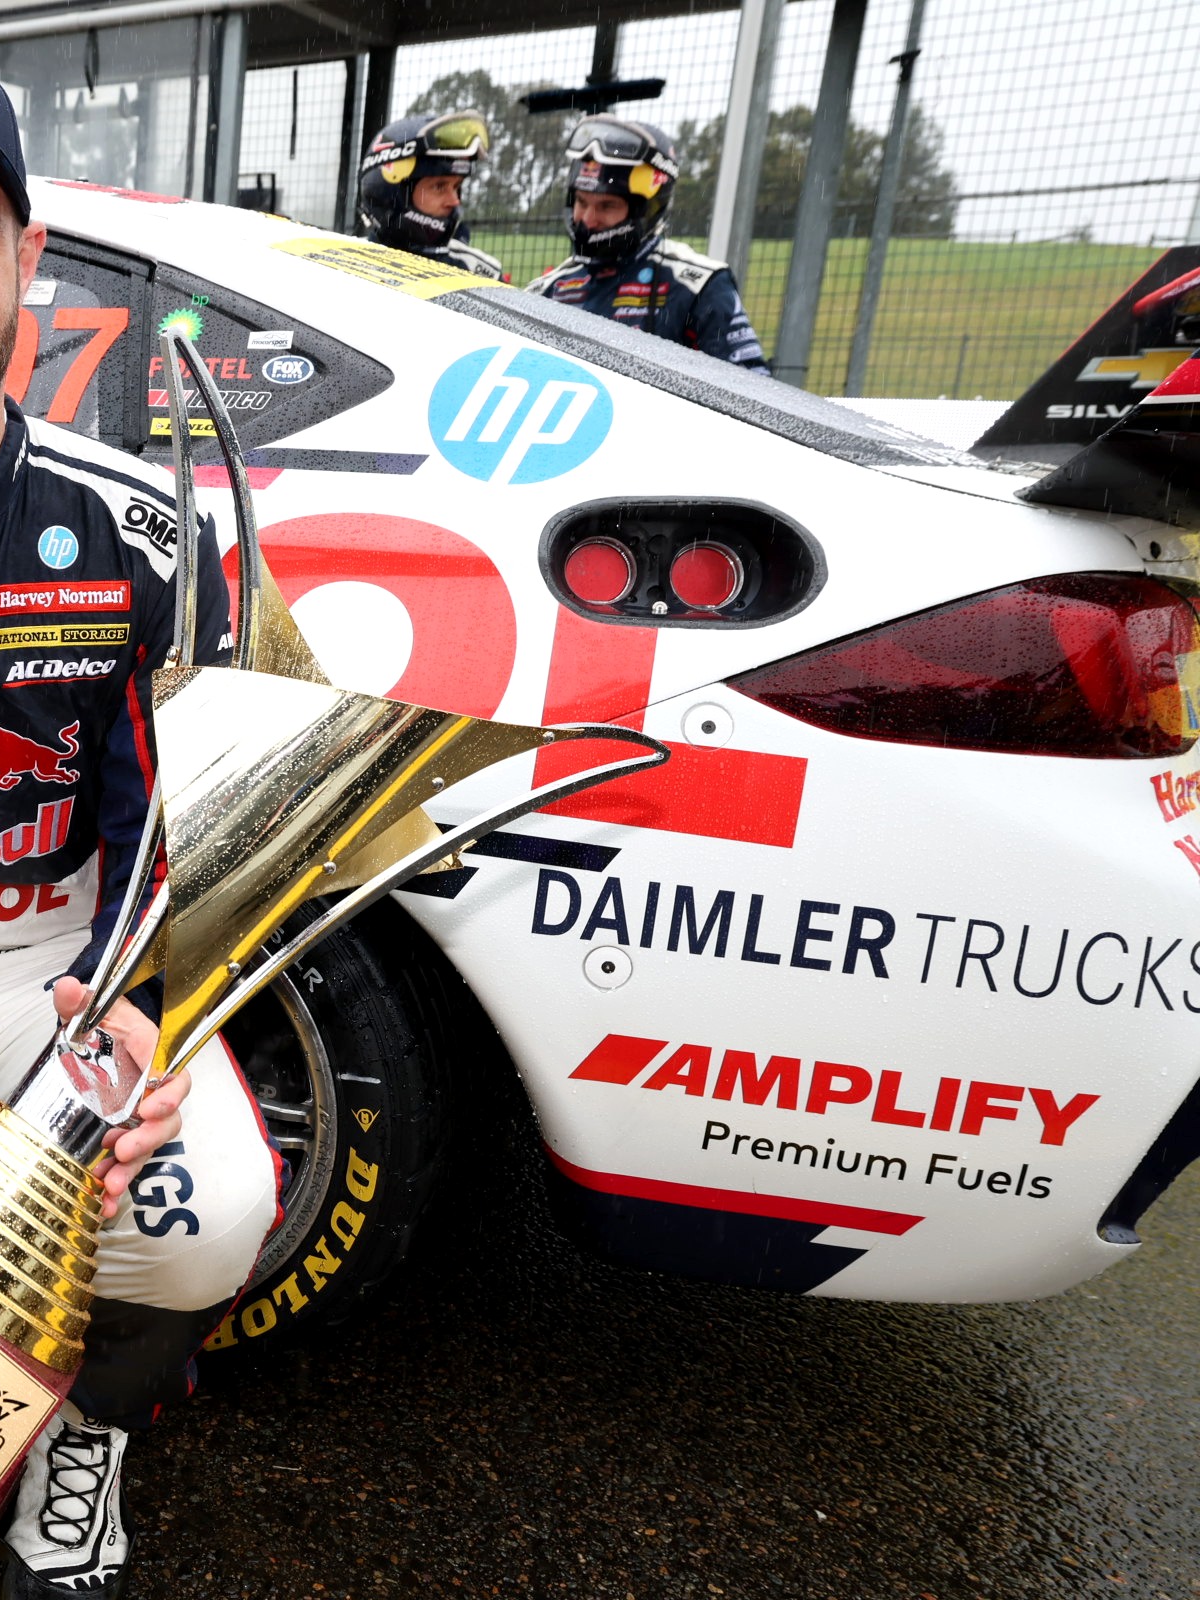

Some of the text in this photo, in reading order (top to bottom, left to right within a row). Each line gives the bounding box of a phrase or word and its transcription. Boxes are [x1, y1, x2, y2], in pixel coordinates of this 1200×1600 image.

[404, 210, 447, 232] AMPOL
[191, 293, 209, 308] bp
[271, 360, 305, 375] FOX
[443, 345, 599, 485] hp
[125, 504, 178, 547] OMP
[44, 528, 74, 568] hp
[0, 587, 123, 608] Harvey Norman
[63, 629, 125, 641] STORAGE
[5, 657, 117, 682] ACDelco
[531, 867, 897, 980] DAIMLER
[641, 1041, 1101, 1147] AMPLIFY
[701, 1121, 1052, 1200] Premium Fuels
